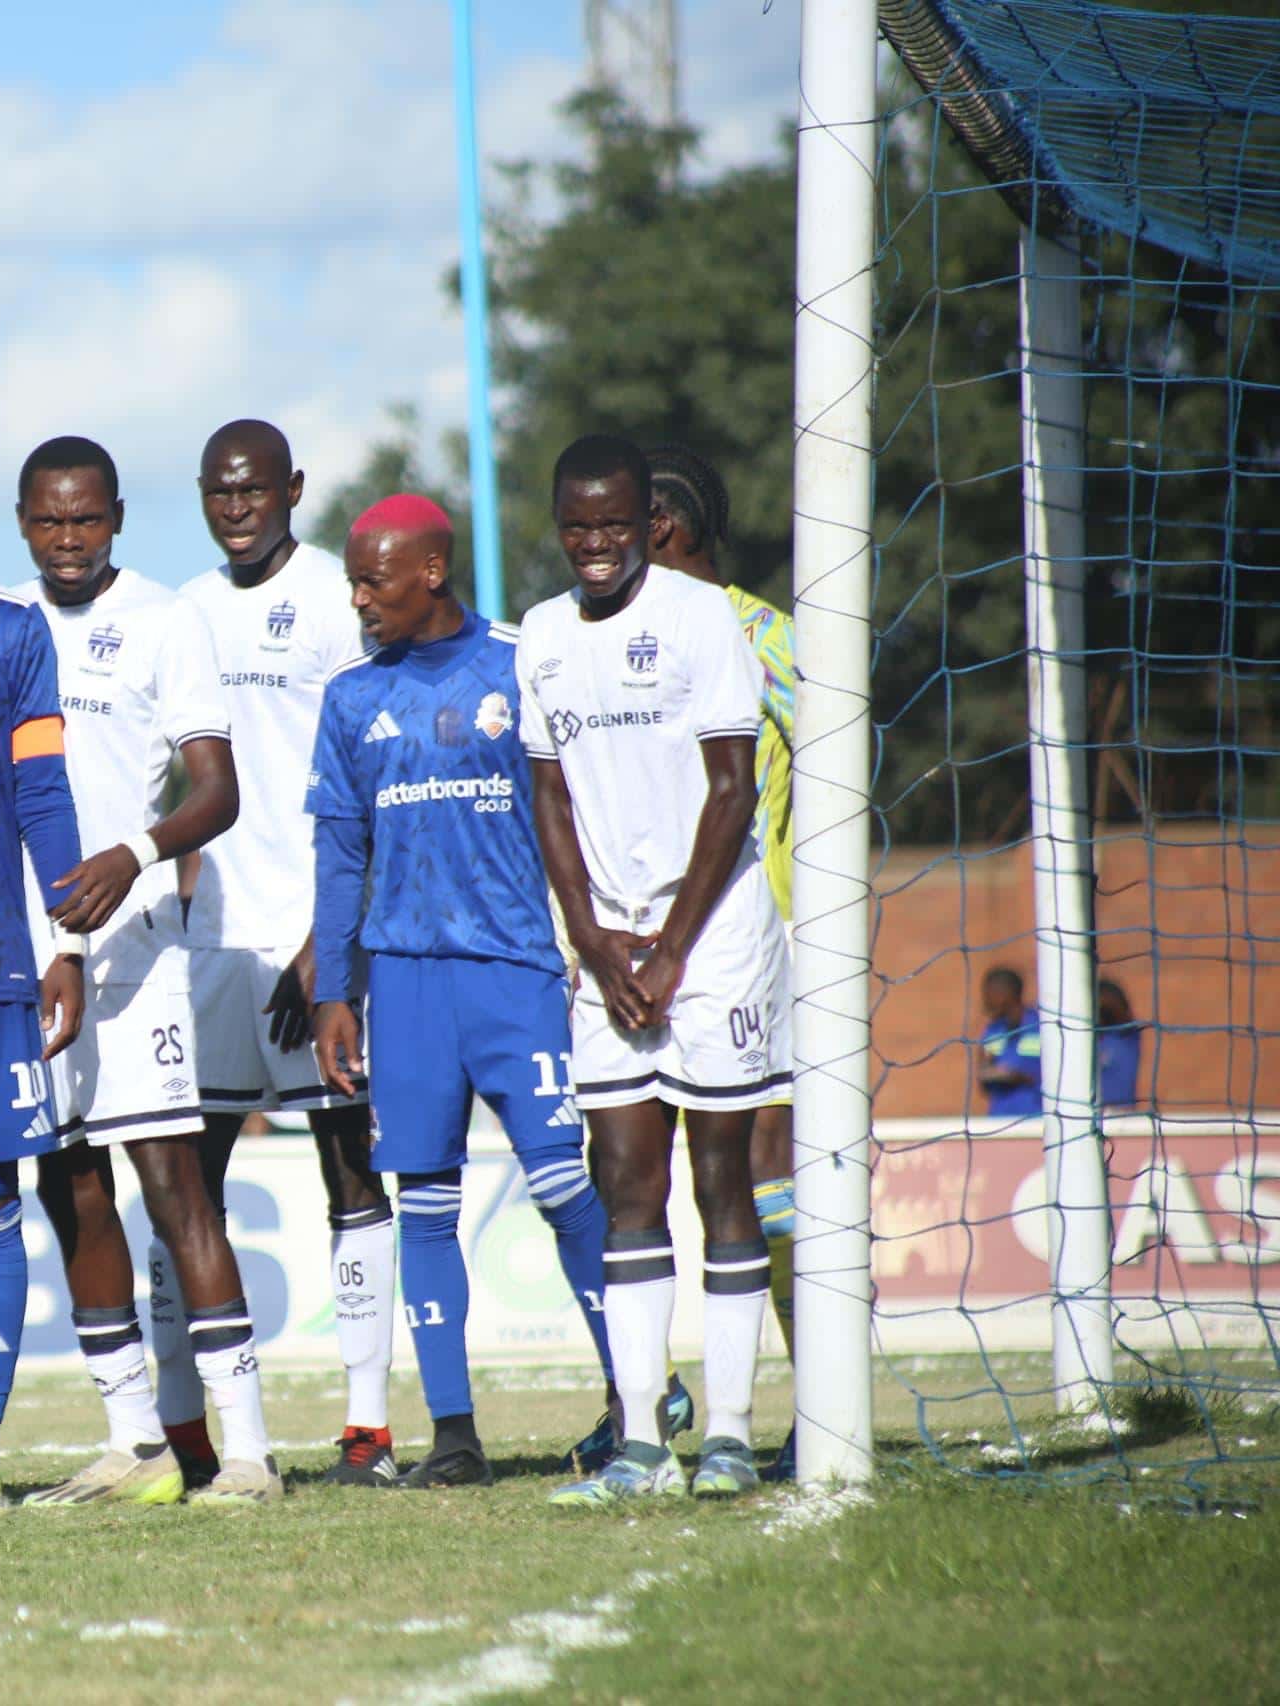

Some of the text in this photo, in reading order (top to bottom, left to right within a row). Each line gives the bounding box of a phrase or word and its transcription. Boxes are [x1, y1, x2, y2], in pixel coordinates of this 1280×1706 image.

[375, 772, 514, 809] etterbrands
[729, 1003, 764, 1049] 04
[9, 1059, 48, 1110] 10
[531, 1051, 577, 1097] 11
[339, 1260, 365, 1286] 06
[405, 1301, 445, 1328] 11
